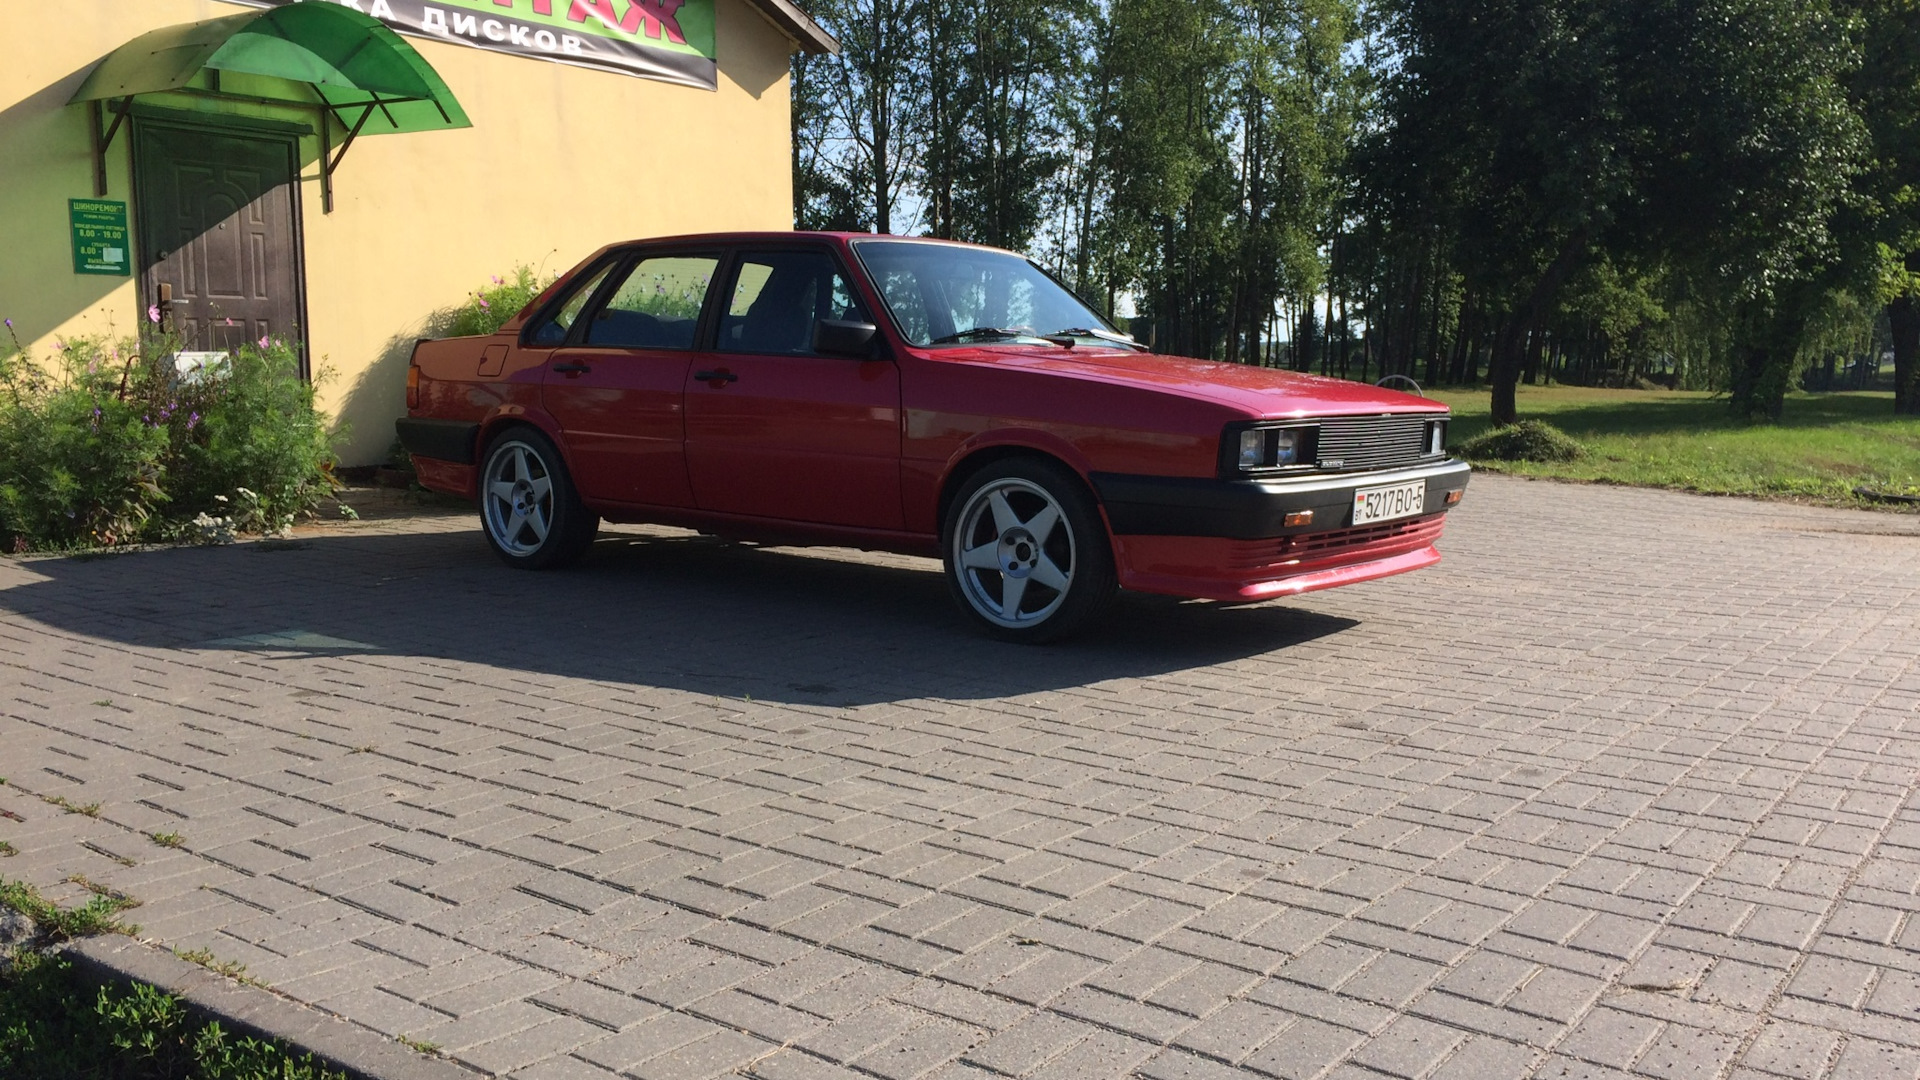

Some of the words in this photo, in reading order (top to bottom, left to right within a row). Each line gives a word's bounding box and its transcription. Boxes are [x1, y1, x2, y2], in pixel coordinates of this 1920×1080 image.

[421, 6, 583, 54] ДИСКОВ
[73, 202, 123, 213] ШИНОРЕМОНТ
[79, 229, 95, 237] 8.00
[103, 231, 122, 239] 19.00
